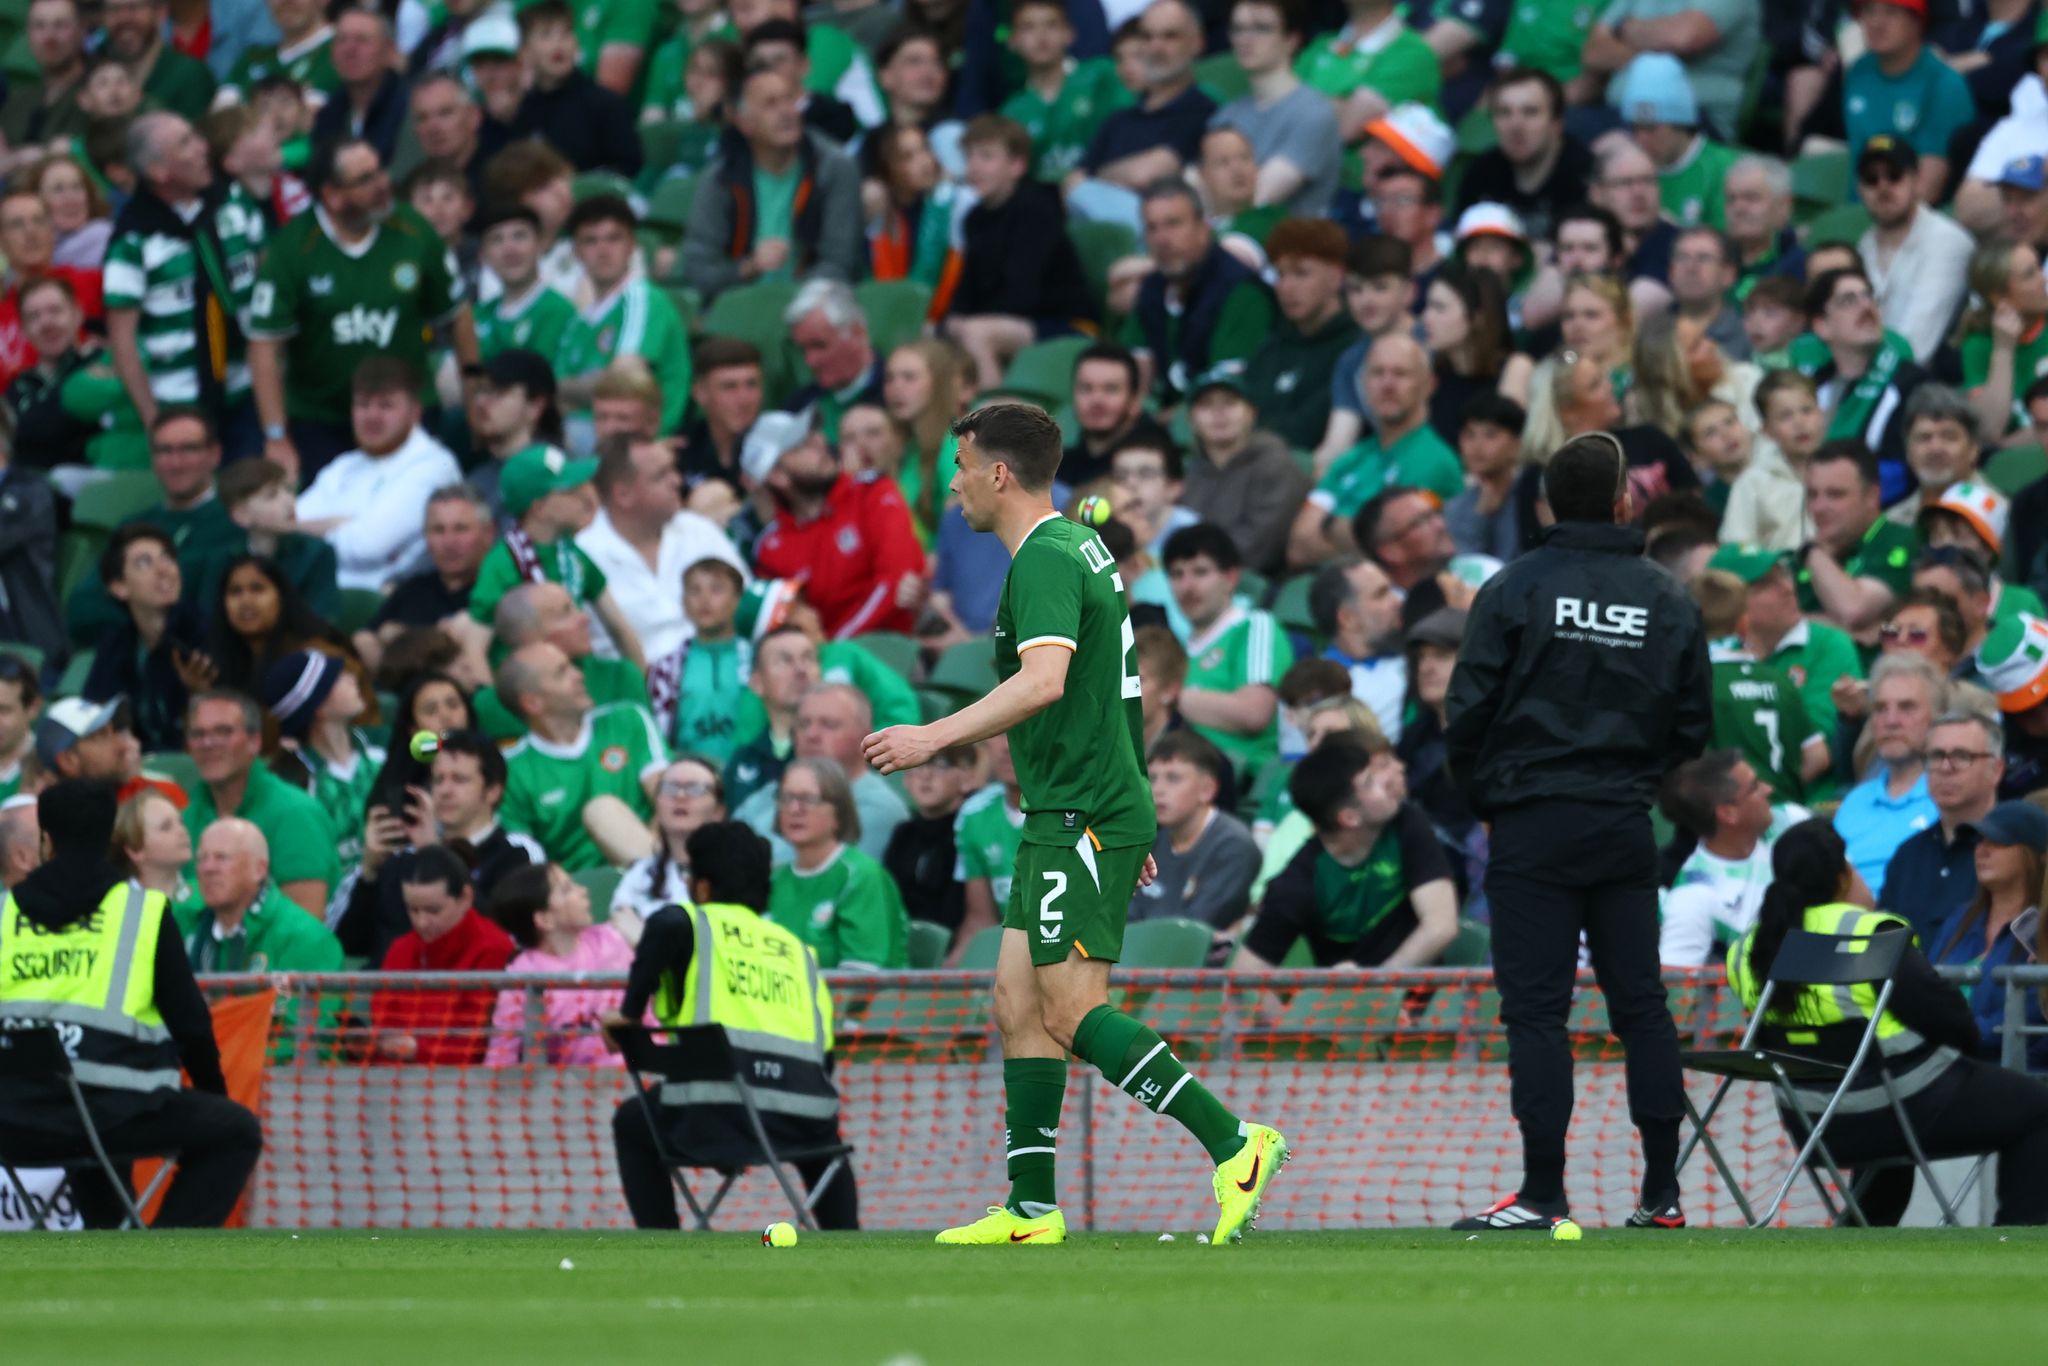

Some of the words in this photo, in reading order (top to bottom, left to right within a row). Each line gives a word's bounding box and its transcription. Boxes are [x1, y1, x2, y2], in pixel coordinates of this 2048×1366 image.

[331, 303, 398, 348] sky
[1555, 597, 1649, 637] PULSE
[1554, 631, 1584, 642] security
[1588, 633, 1643, 648] management
[1753, 709, 1783, 773] 7
[1040, 871, 1067, 920] 2
[753, 1061, 782, 1079] 170
